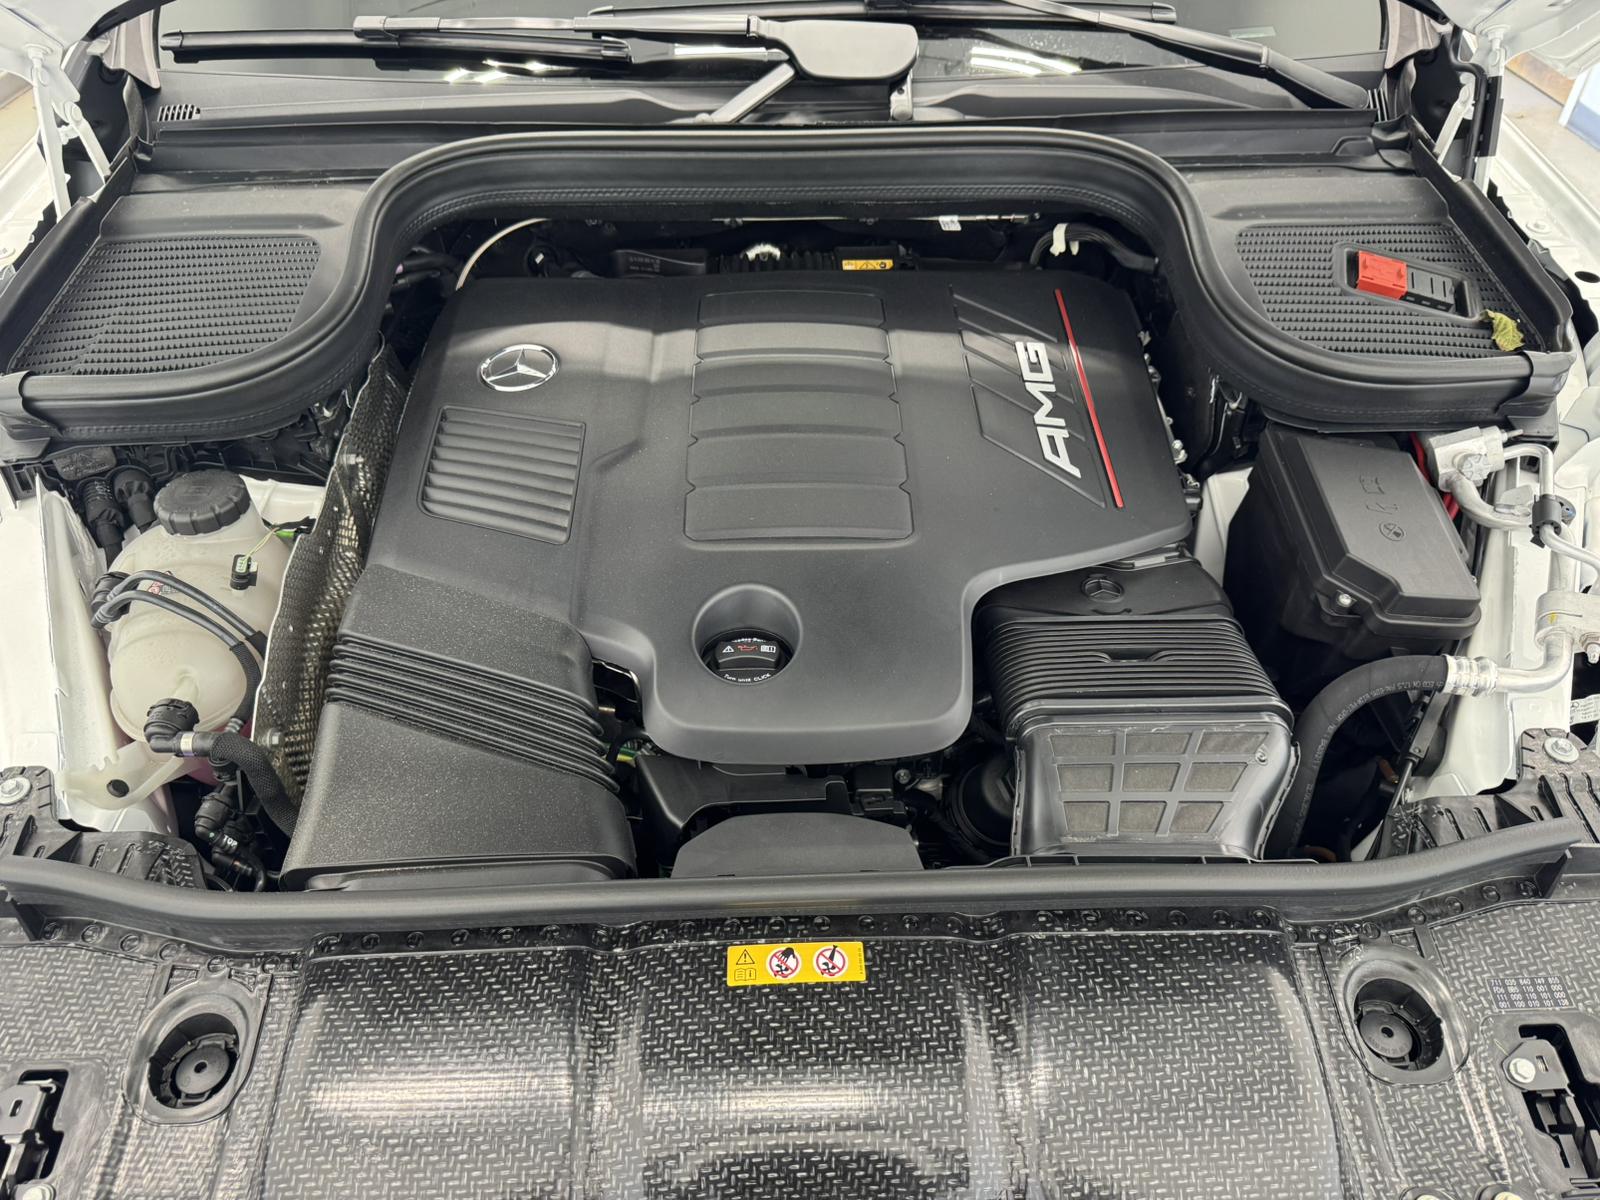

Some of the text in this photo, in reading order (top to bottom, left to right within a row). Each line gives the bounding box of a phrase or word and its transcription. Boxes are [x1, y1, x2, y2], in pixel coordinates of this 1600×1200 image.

[1015, 341, 1082, 478] AMG
[724, 673, 736, 682] Turn
[753, 672, 771, 682] CLICK
[224, 834, 238, 847] TOP
